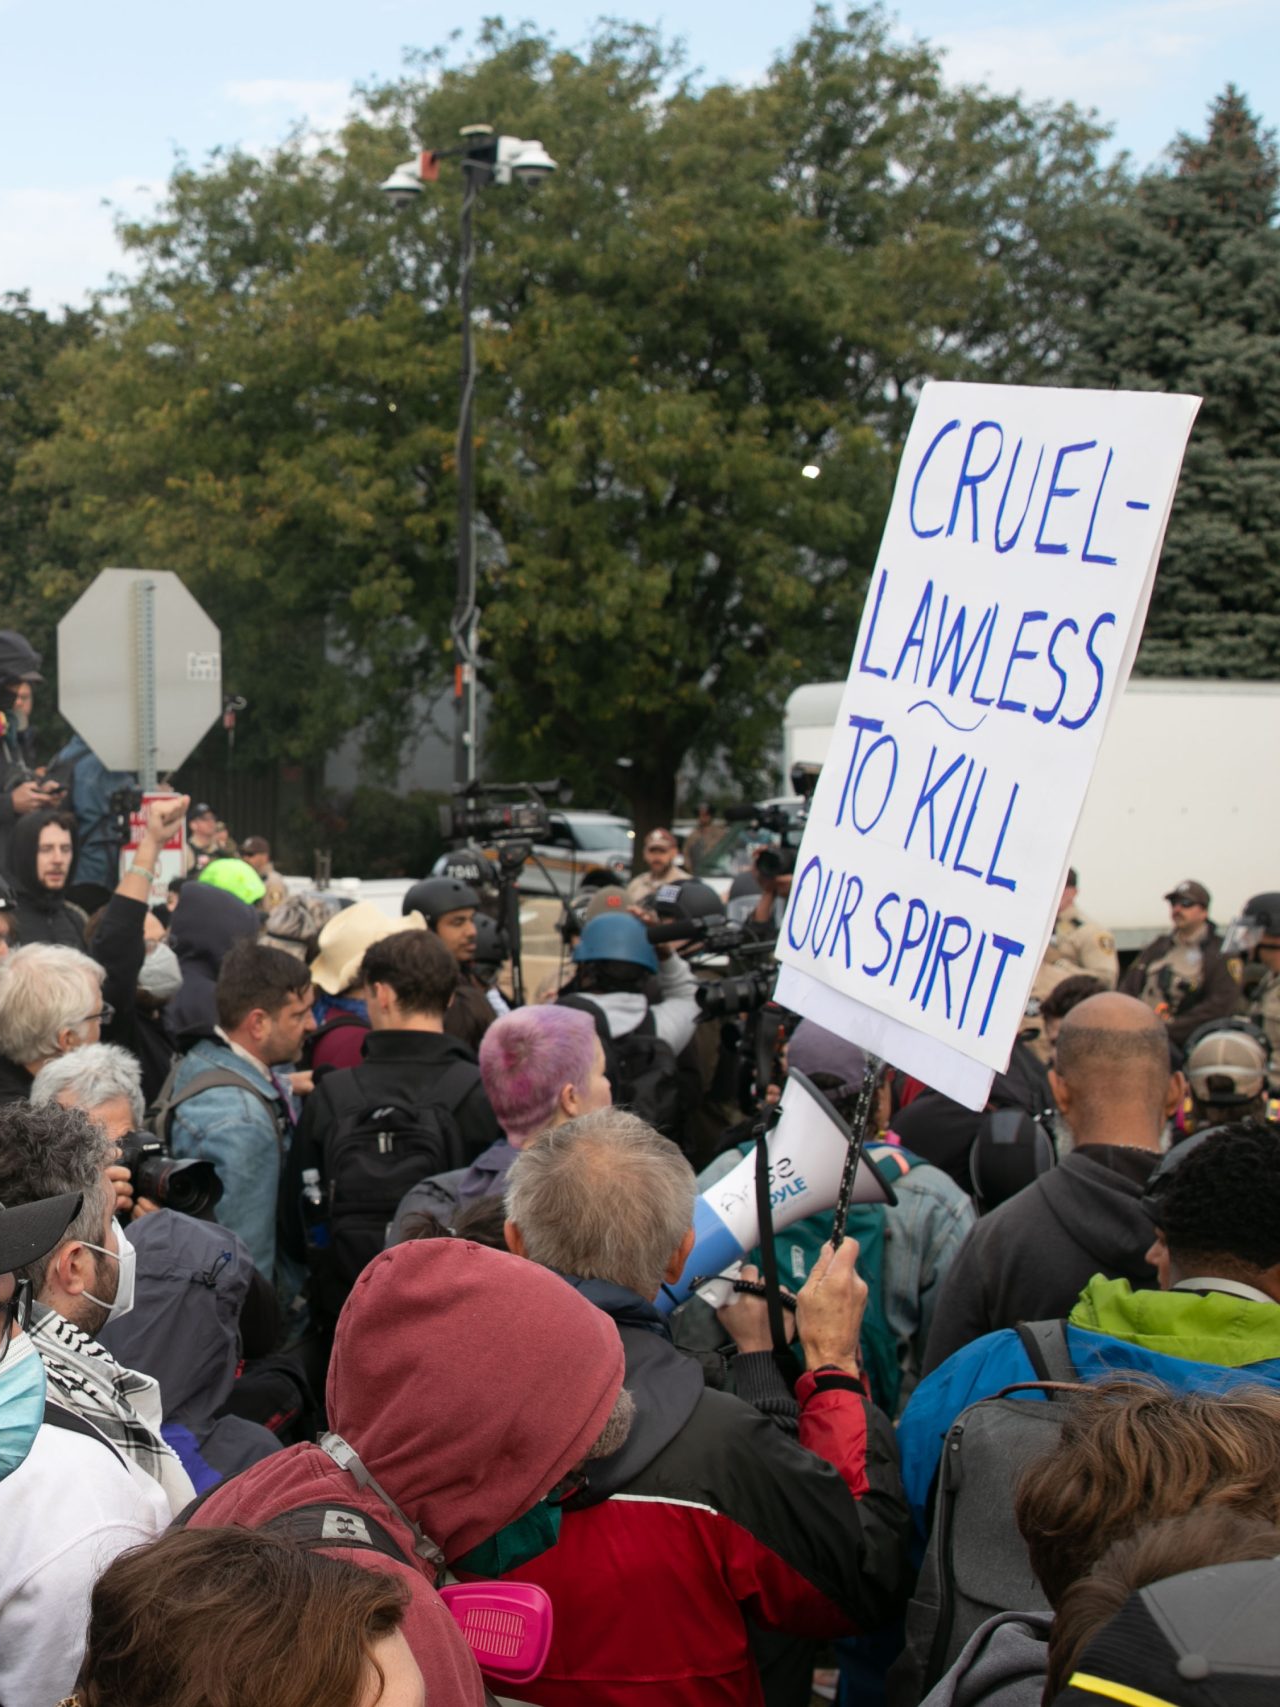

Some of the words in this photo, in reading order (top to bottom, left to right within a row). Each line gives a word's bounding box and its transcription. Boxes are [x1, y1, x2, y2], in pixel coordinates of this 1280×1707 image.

[909, 419, 1150, 566] CRUEL-
[859, 569, 1116, 729] LAWLESS
[835, 715, 898, 835] TO
[904, 745, 1019, 892] KILL
[788, 856, 863, 969] OUR
[862, 892, 1024, 1037] SPIRIT
